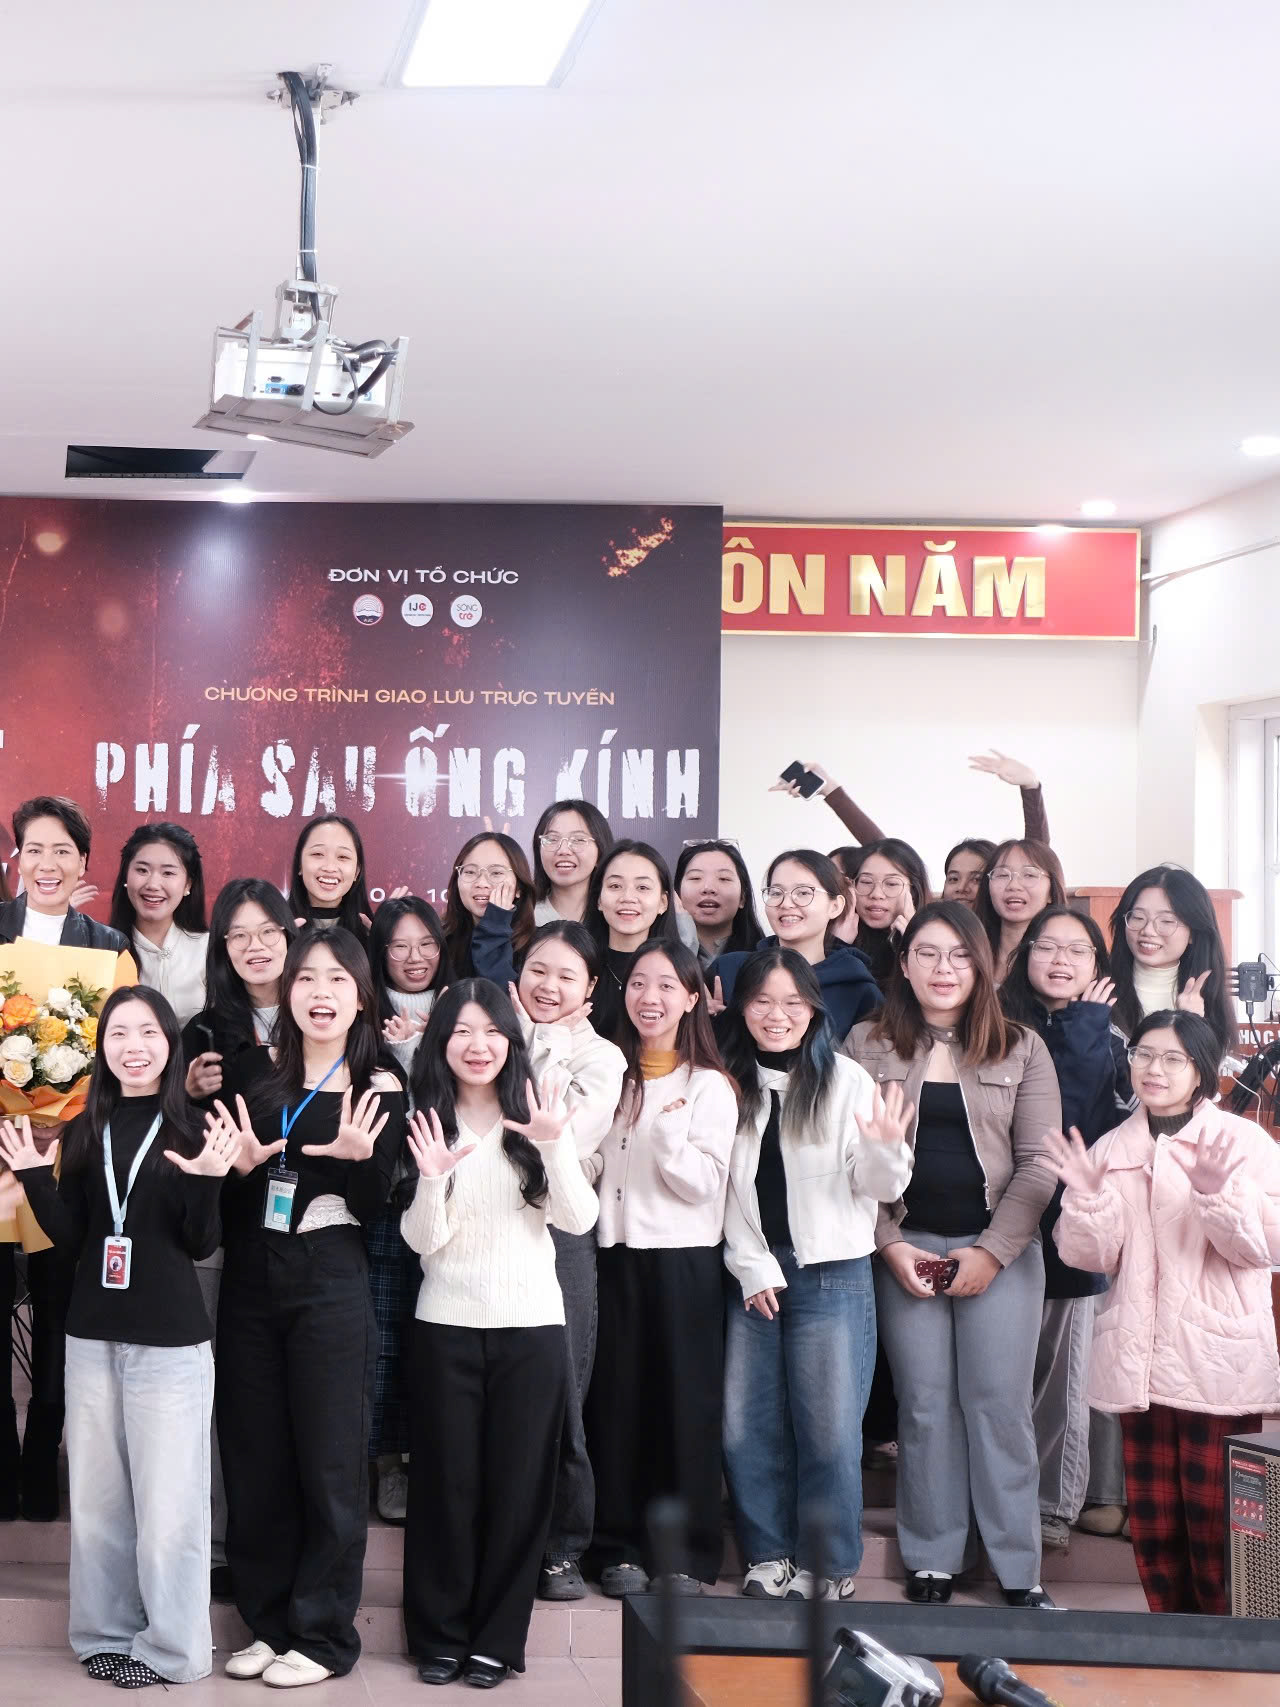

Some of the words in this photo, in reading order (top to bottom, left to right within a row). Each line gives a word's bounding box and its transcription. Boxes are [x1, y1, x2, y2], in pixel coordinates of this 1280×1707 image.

[328, 567, 380, 583] ĐƠN
[387, 569, 409, 585] VỊ
[415, 566, 447, 583] TỔ
[453, 567, 519, 584] CHỨC
[721, 537, 825, 615] ÔN
[850, 540, 1046, 618] NĂM
[204, 685, 298, 702] CHƯƠNG
[304, 686, 369, 703] TRÌNH
[375, 688, 428, 704] GIAO
[433, 688, 475, 704] LƯU
[481, 689, 538, 707] TRỰC
[95, 724, 237, 815] PHÍA
[260, 738, 377, 818] SAU
[405, 724, 526, 818] ỐNG
[556, 728, 700, 819] KÍNH
